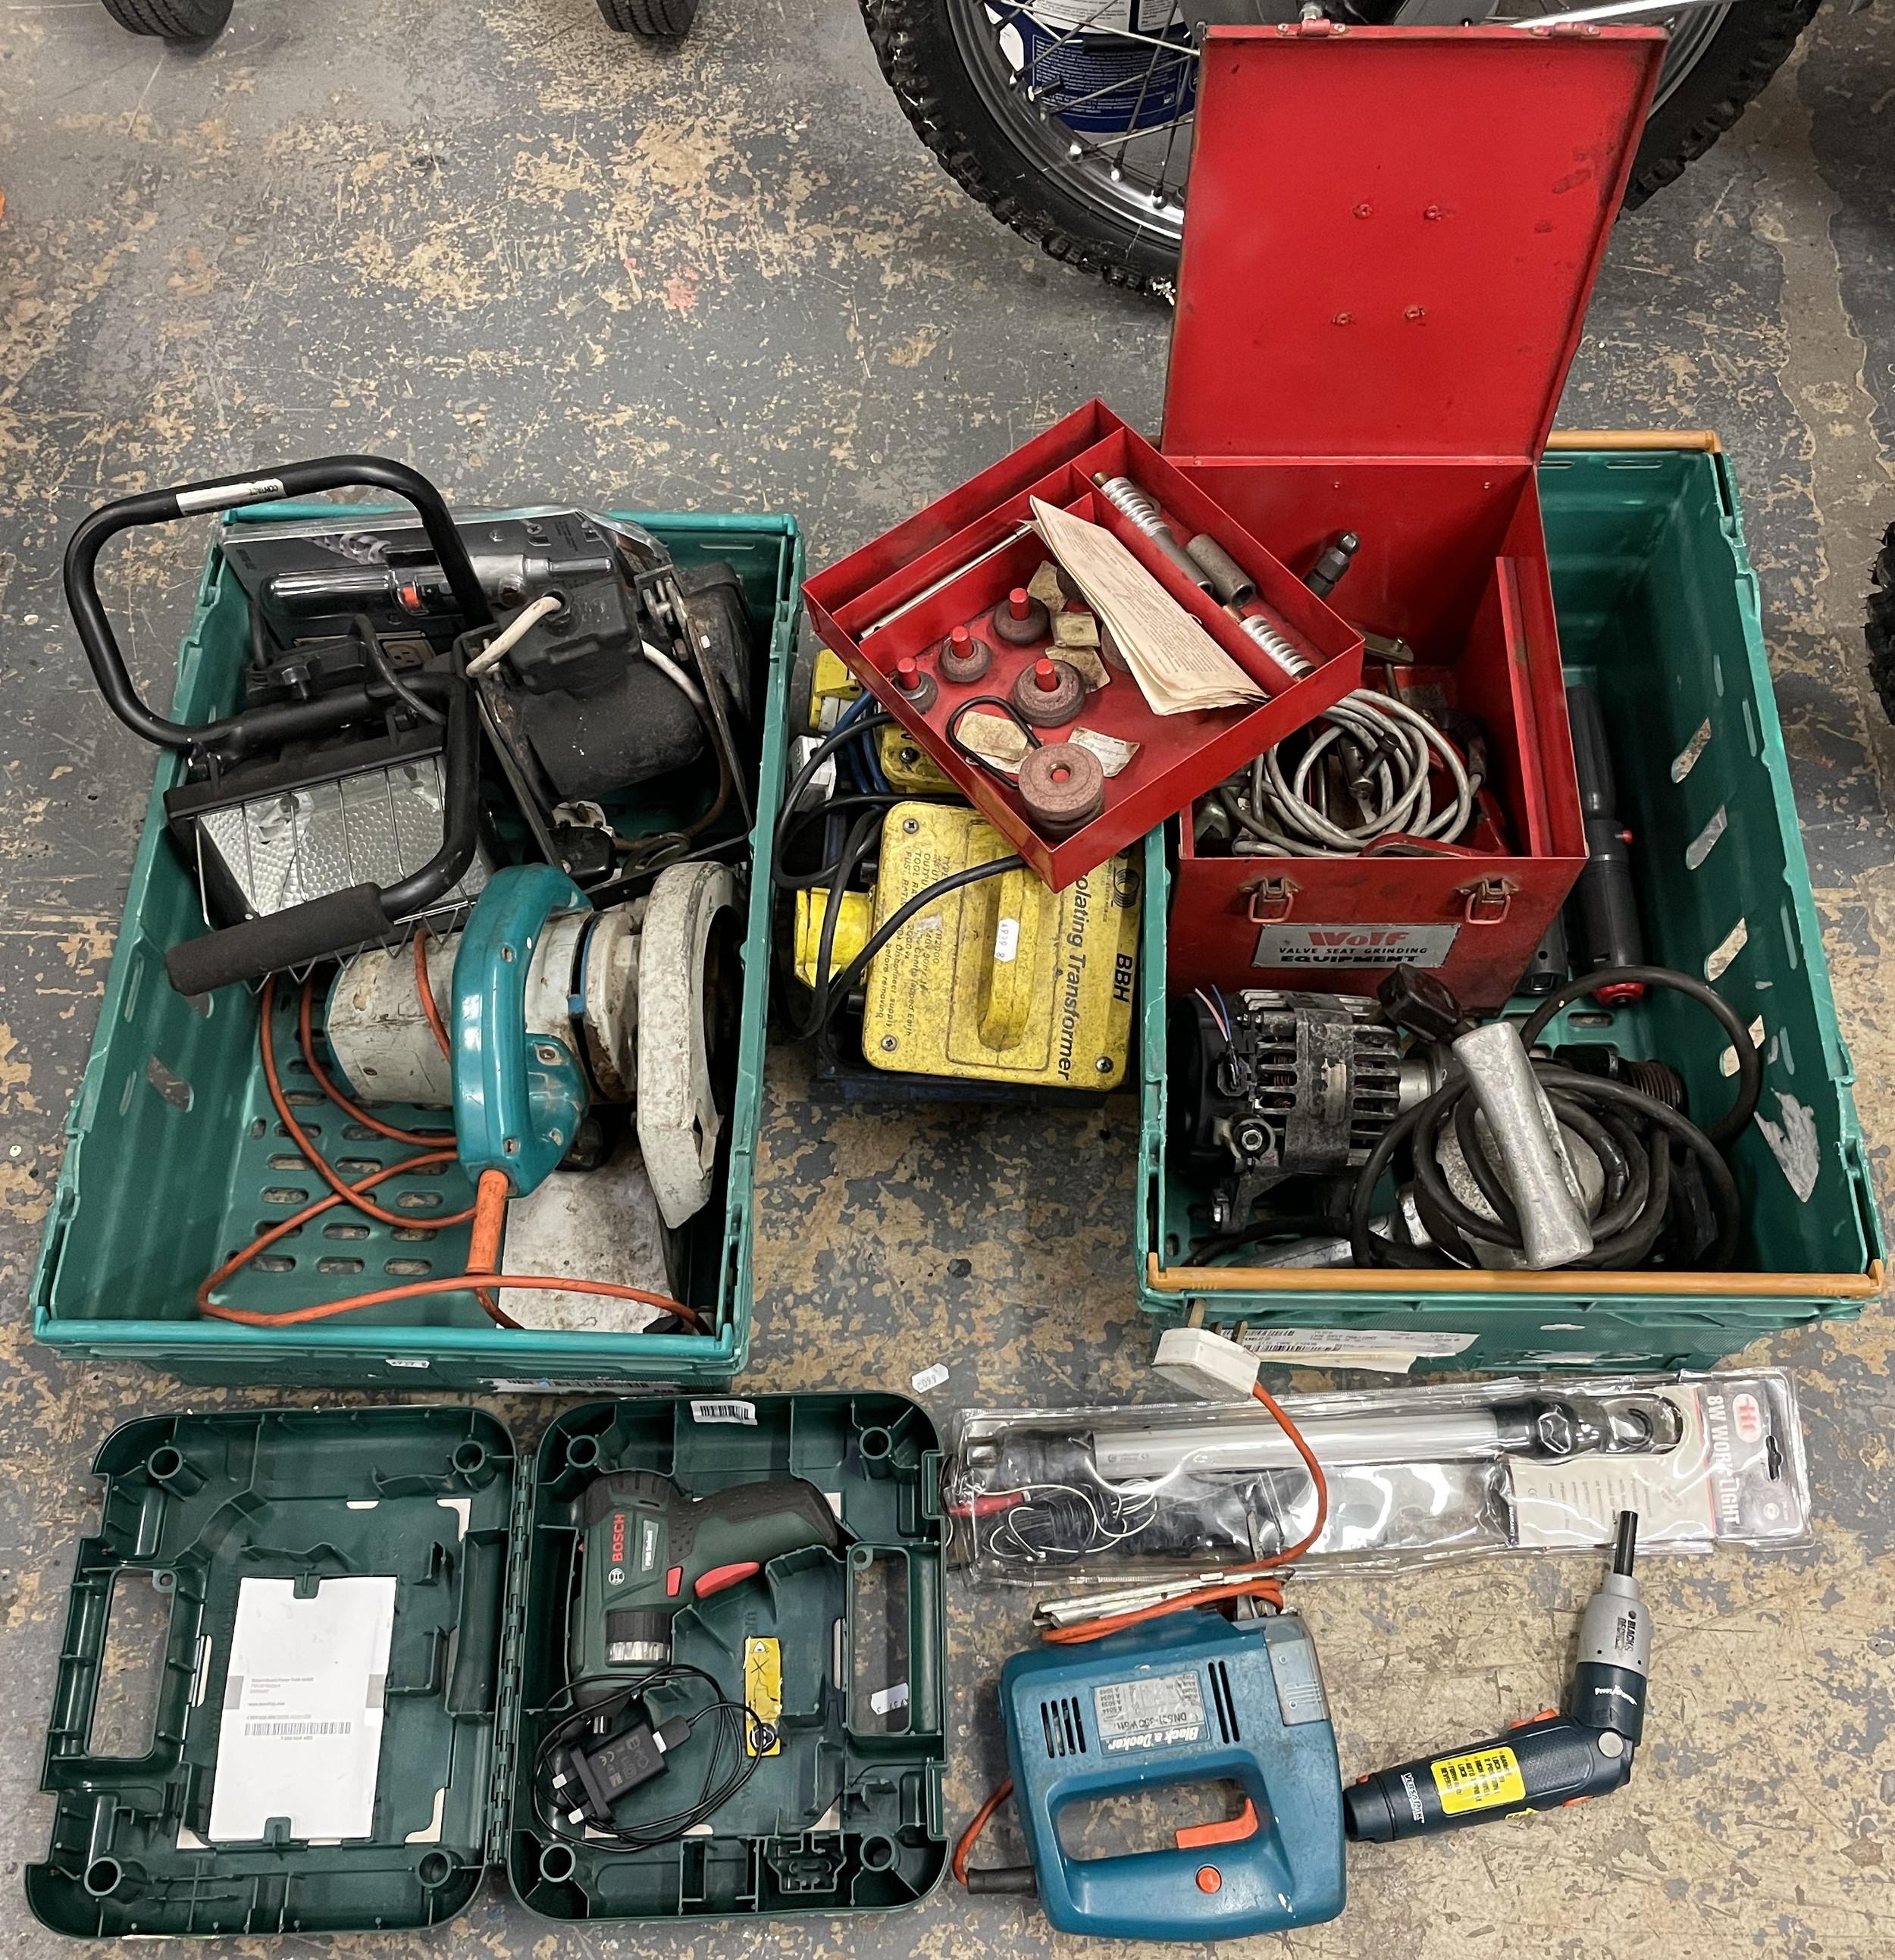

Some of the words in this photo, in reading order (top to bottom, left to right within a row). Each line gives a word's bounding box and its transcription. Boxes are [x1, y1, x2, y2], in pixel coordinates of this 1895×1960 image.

[920, 853, 931, 890] OUTPU
[1113, 953, 1133, 1002] BBH
[1057, 954, 1086, 1081] Transformer
[1706, 1395, 1727, 1422] 8W
[1718, 1477, 1741, 1525] LIGHT
[612, 1514, 625, 1562] BOSCH
[1107, 1733, 1153, 1751] Decker
[1164, 1726, 1199, 1745] Black
